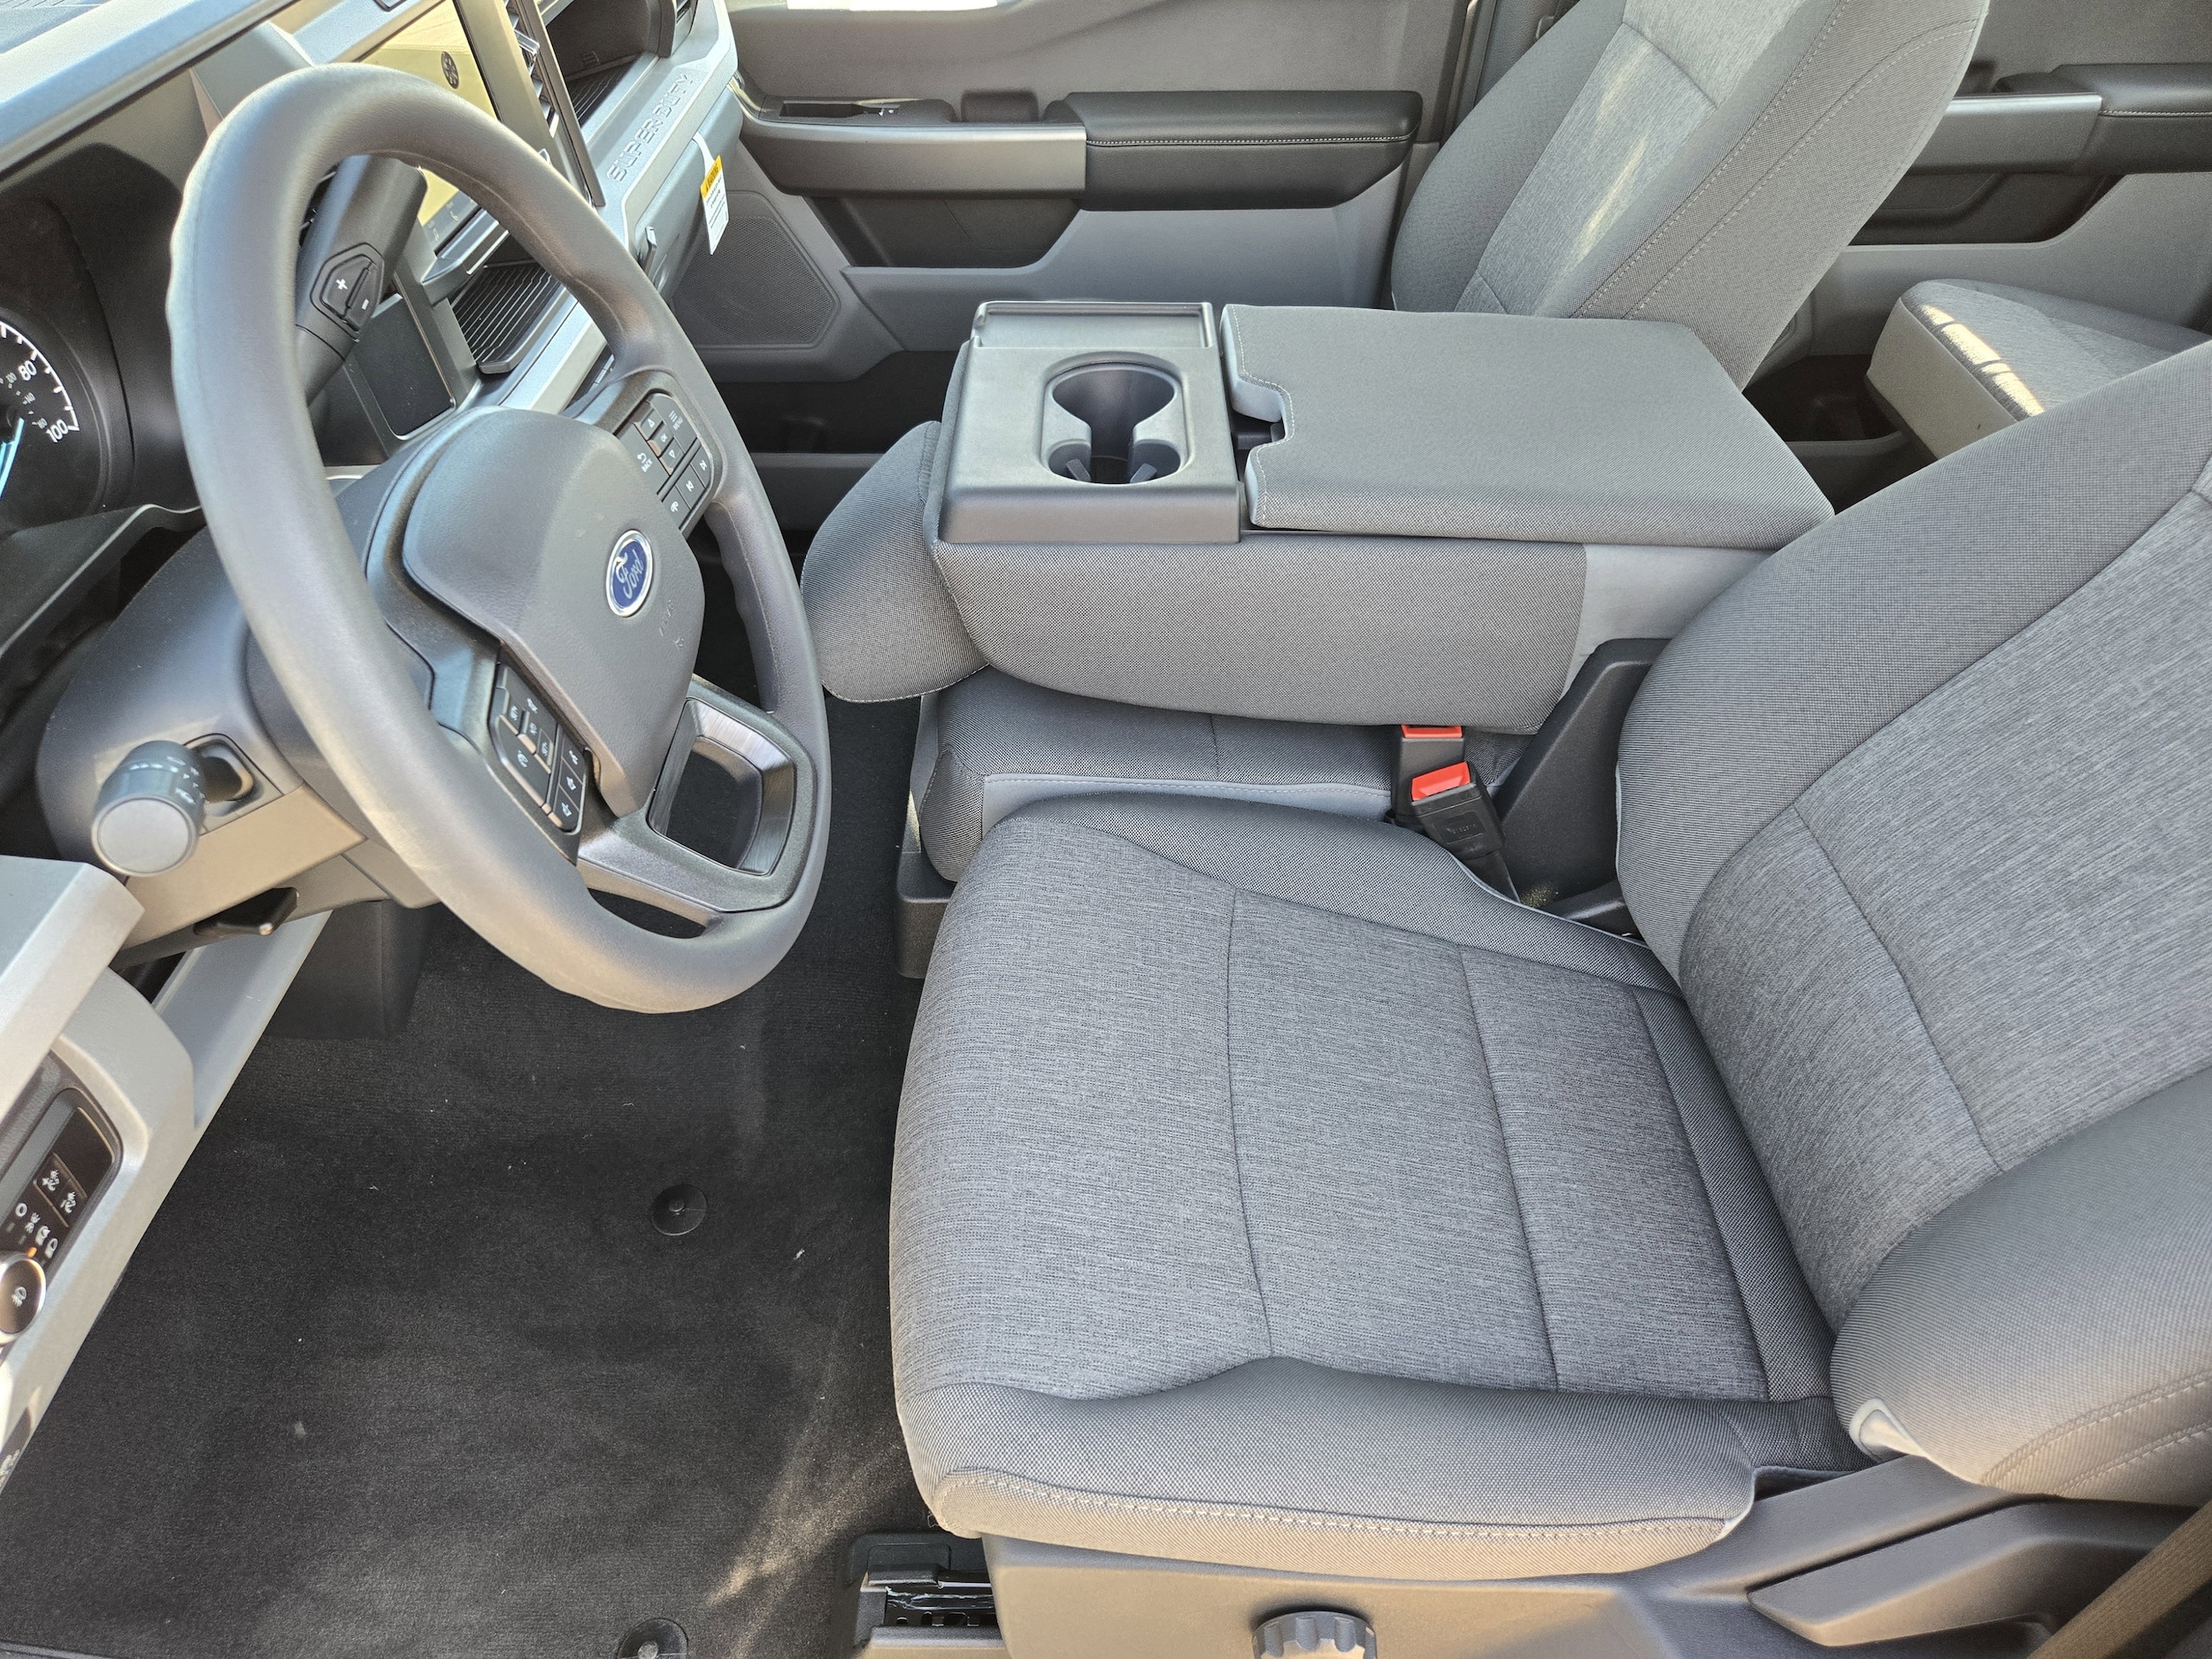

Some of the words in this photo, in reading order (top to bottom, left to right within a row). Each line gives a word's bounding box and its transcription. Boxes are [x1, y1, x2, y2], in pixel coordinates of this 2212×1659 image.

[606, 118, 664, 182] SUPER
[652, 73, 694, 118] DUTY
[18, 359, 37, 381] 80
[45, 419, 69, 443] 100
[614, 549, 645, 600] Ford
